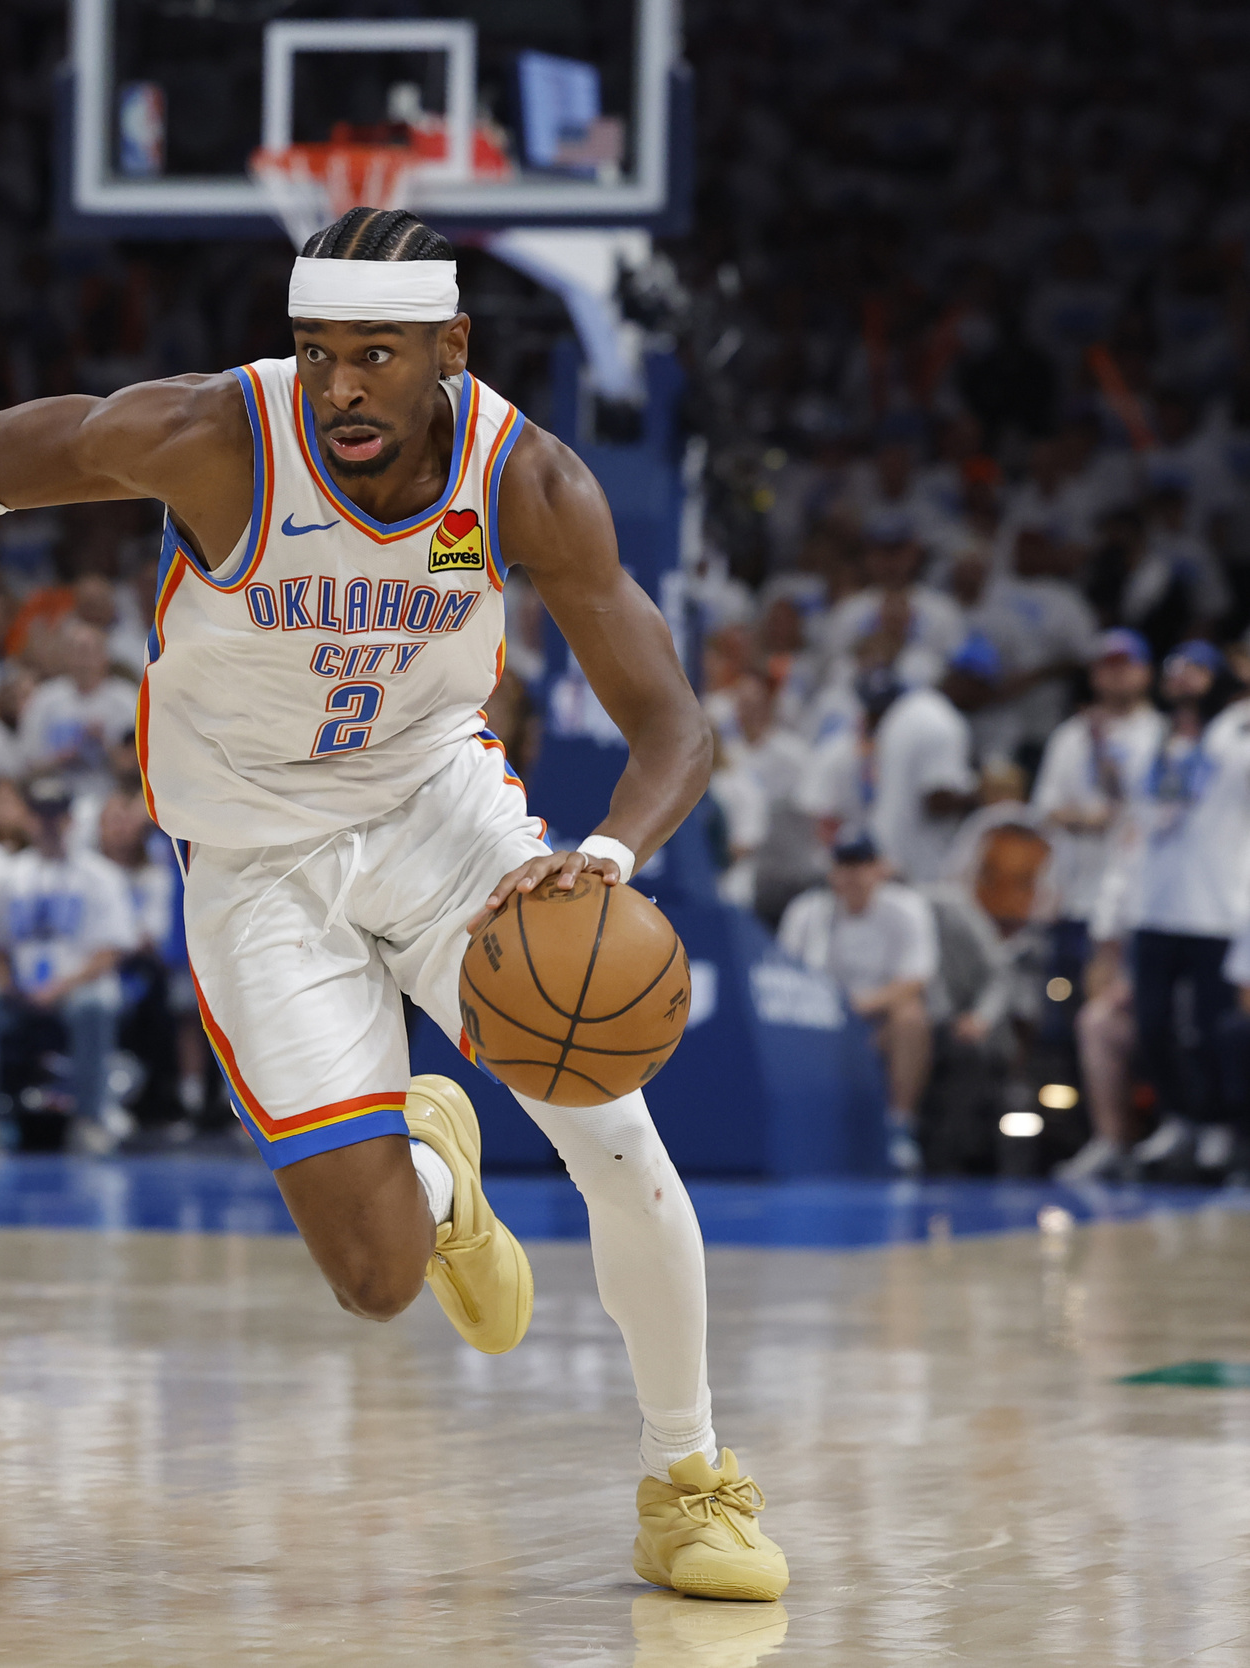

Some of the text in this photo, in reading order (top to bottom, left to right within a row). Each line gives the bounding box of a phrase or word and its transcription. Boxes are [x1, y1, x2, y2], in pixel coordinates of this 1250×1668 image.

[245, 576, 481, 634] OKLAHOM
[309, 641, 428, 681] CITY
[310, 681, 385, 758] 2
